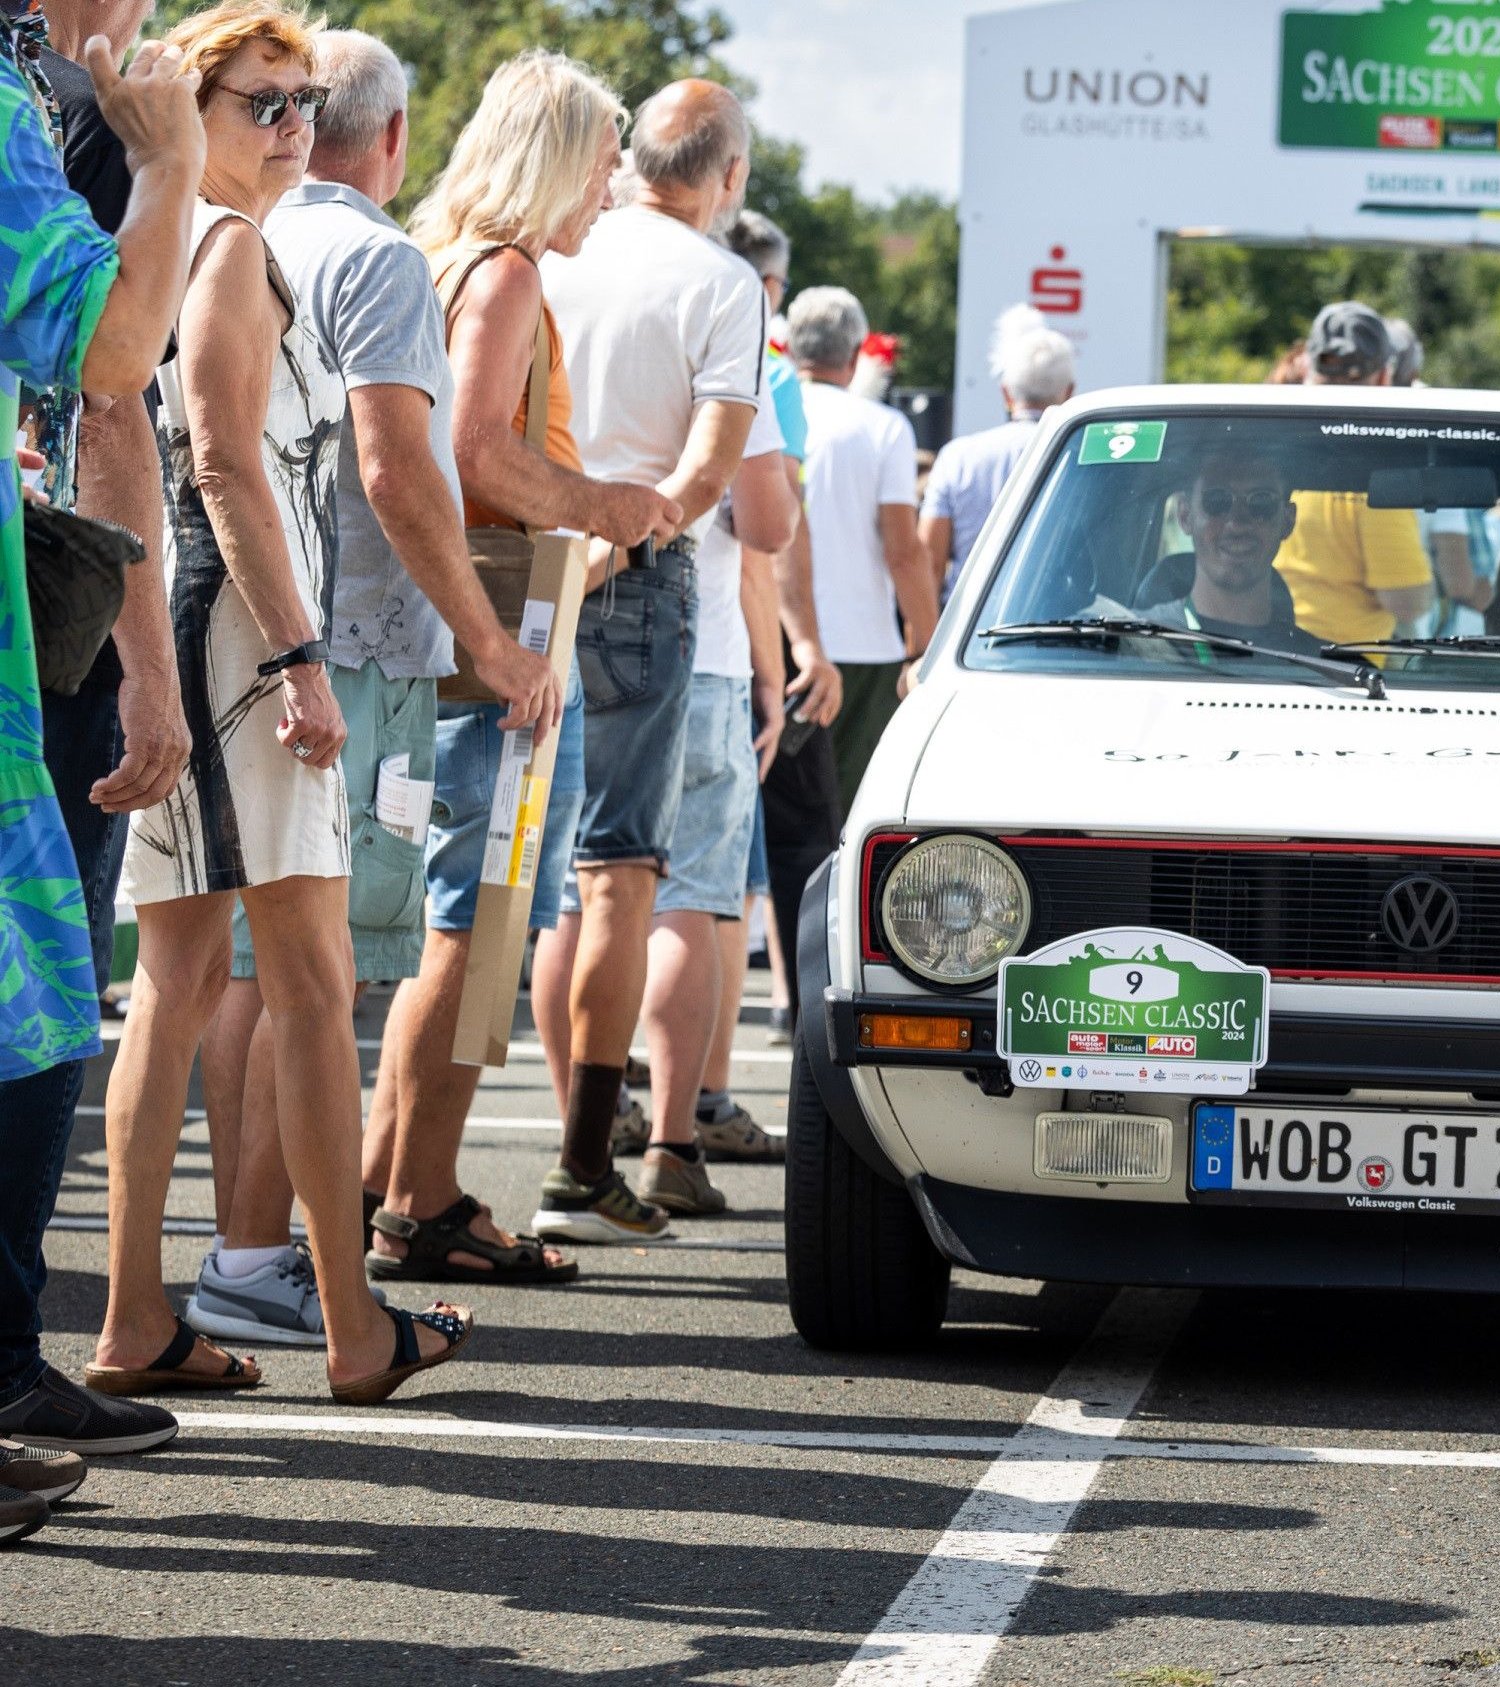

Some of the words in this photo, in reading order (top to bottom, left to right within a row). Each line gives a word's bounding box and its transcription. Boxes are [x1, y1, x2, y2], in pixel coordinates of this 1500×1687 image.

[1024, 67, 1209, 107] UNION
[1302, 50, 1484, 108] SACHSEN
[1126, 971, 1143, 995] 9
[1020, 990, 1136, 1027] SACHSEN
[1143, 999, 1247, 1031] CLASSIC
[1070, 1034, 1099, 1042] auto
[1149, 1037, 1195, 1053] AUTO
[1221, 1031, 1246, 1041] 2024
[1114, 1043, 1144, 1053] Klassik
[1239, 1117, 1353, 1184] WOB
[1403, 1123, 1478, 1189] GT
[1207, 1156, 1222, 1175] D
[1346, 1196, 1415, 1211] Volkswagen
[1417, 1198, 1456, 1211] Classic
